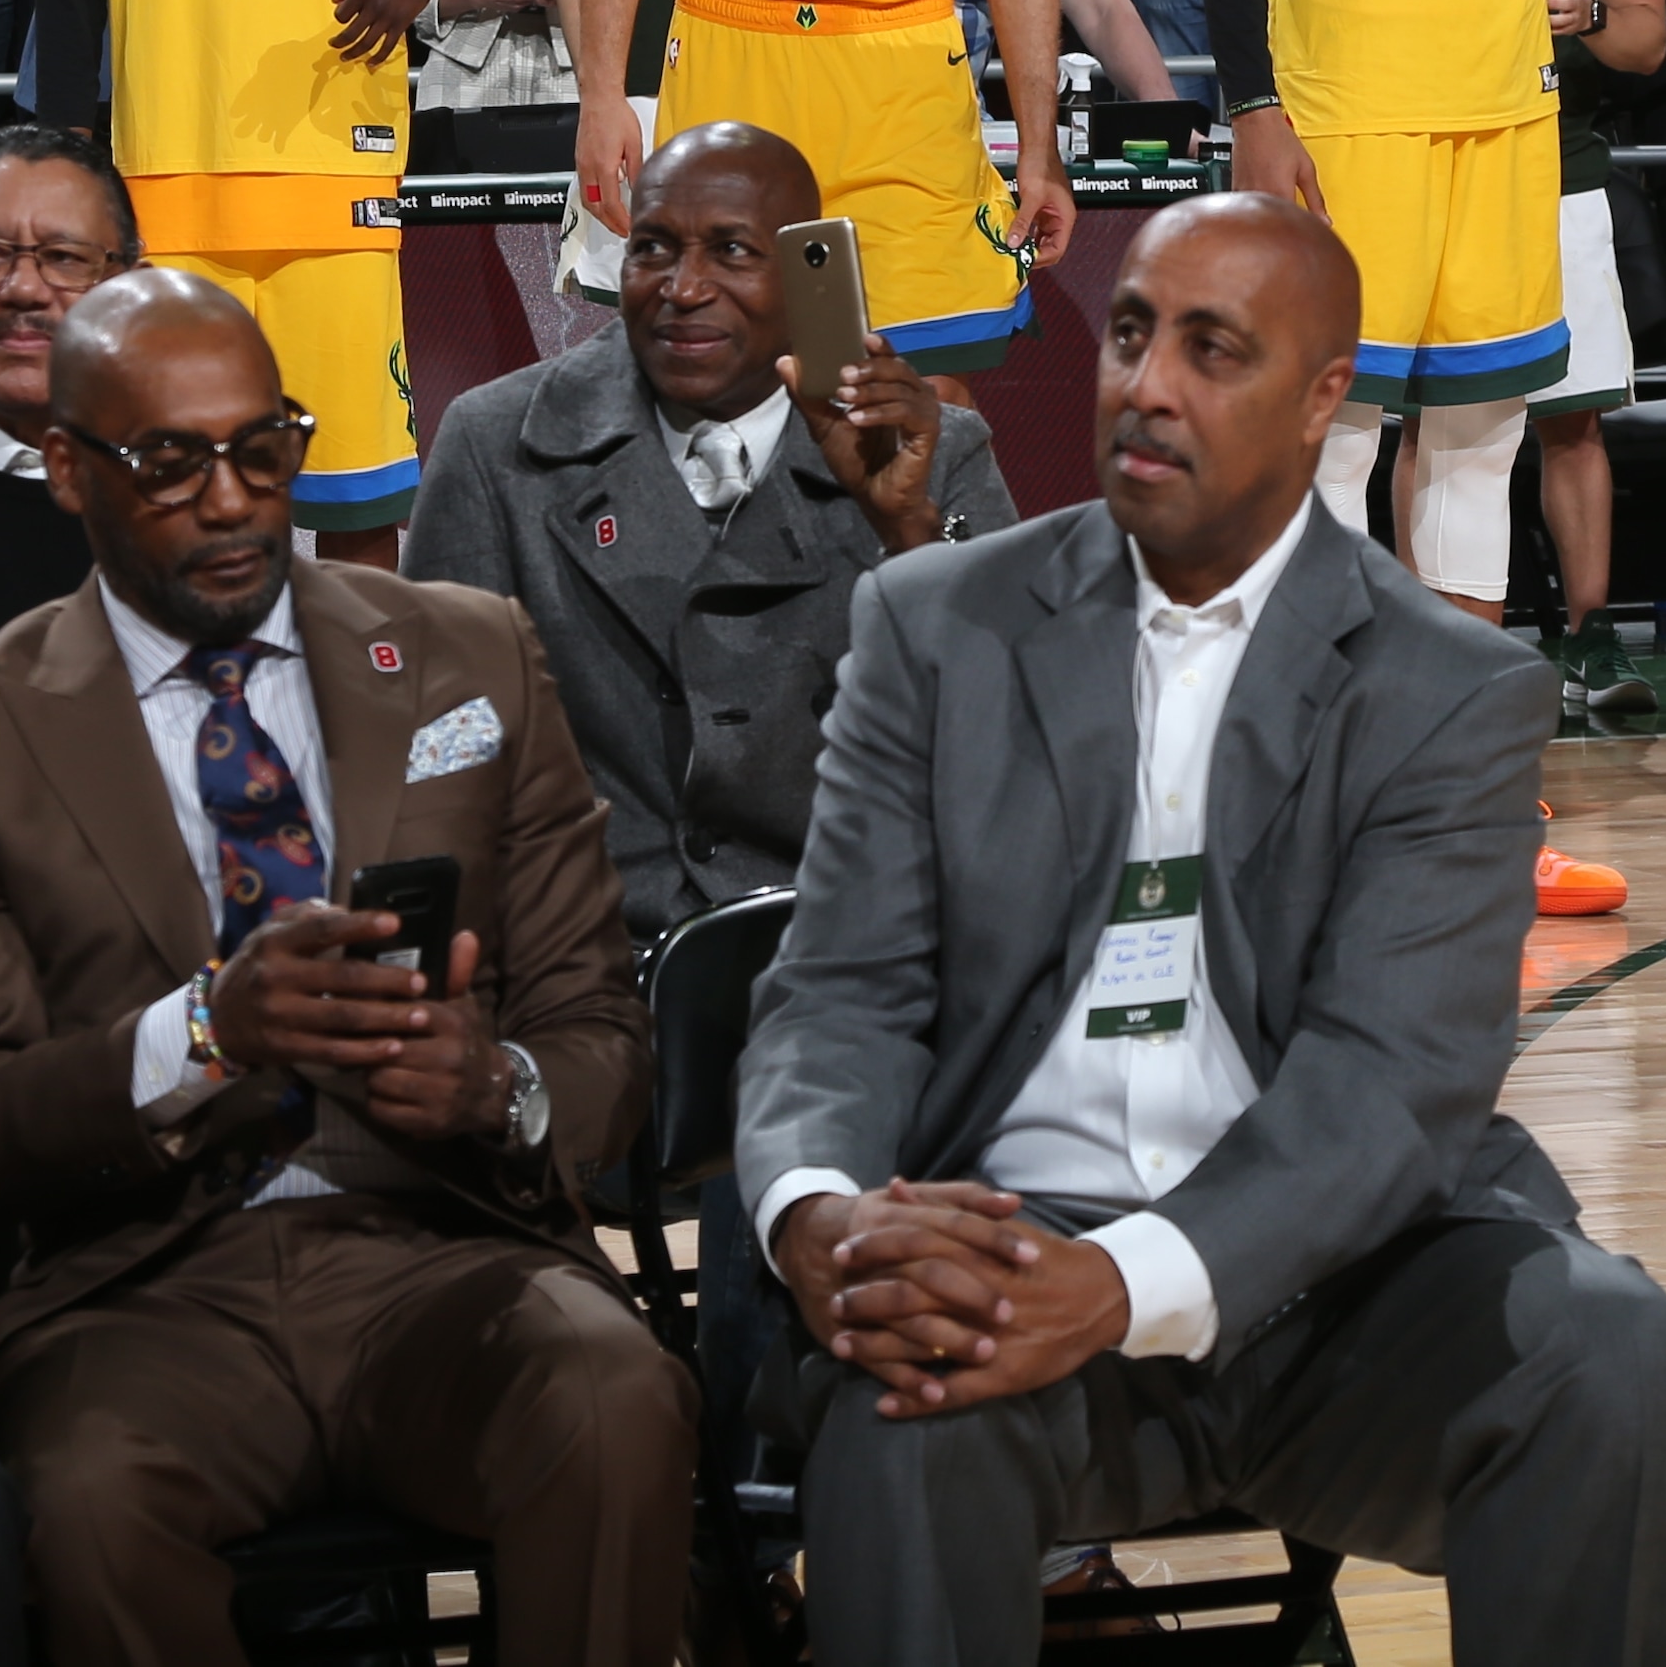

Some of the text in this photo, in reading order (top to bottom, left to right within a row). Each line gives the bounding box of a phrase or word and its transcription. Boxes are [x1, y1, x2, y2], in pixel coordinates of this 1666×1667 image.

[1083, 175, 1199, 194] impact impact
[442, 192, 491, 211] impact
[514, 191, 565, 210] impact
[1126, 1008, 1152, 1024] VIP
